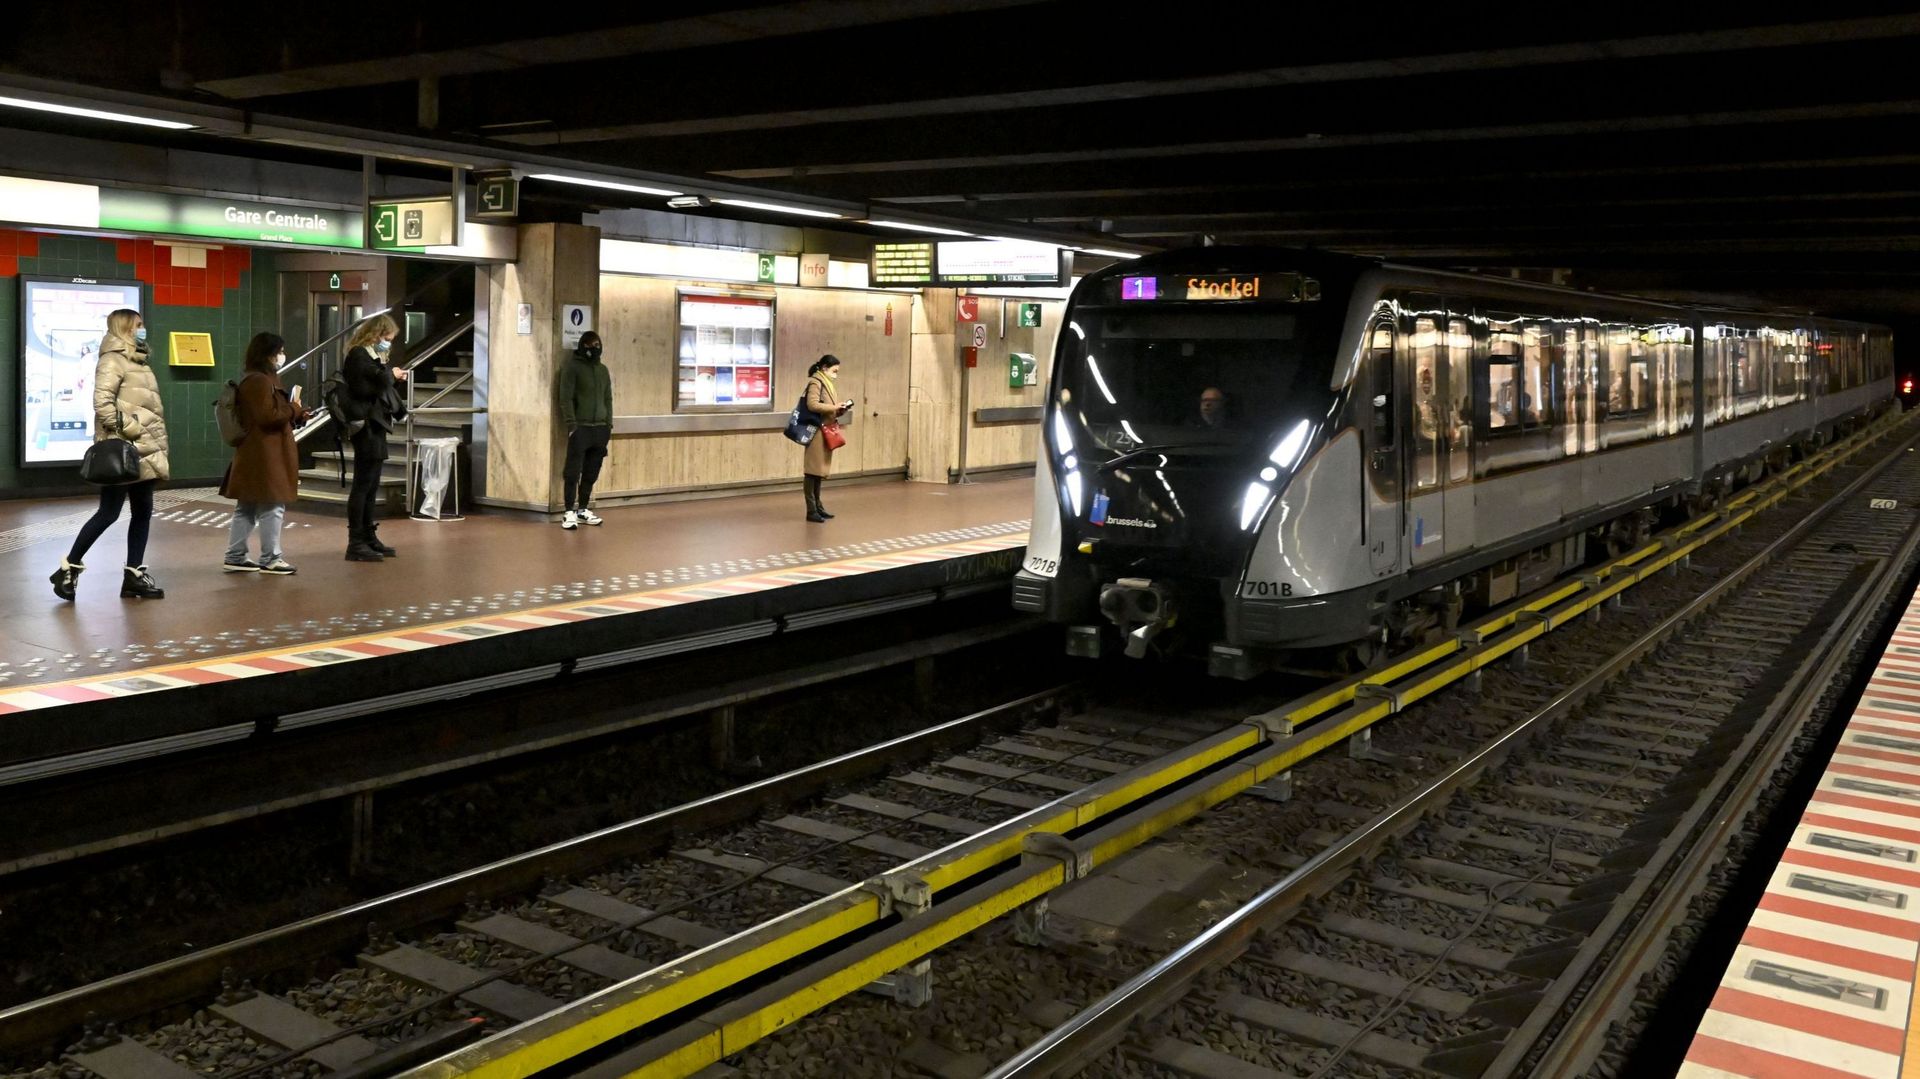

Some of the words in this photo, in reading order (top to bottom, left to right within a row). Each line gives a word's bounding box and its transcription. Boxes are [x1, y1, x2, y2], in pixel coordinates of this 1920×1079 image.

[224, 206, 262, 225] Gare
[265, 210, 328, 231] Centrale
[803, 263, 826, 278] Info
[1134, 279, 1143, 298] 1
[1187, 277, 1260, 298] Stockel
[1872, 500, 1894, 508] 40
[1029, 557, 1057, 573] 701B
[1246, 581, 1293, 597] 701B
